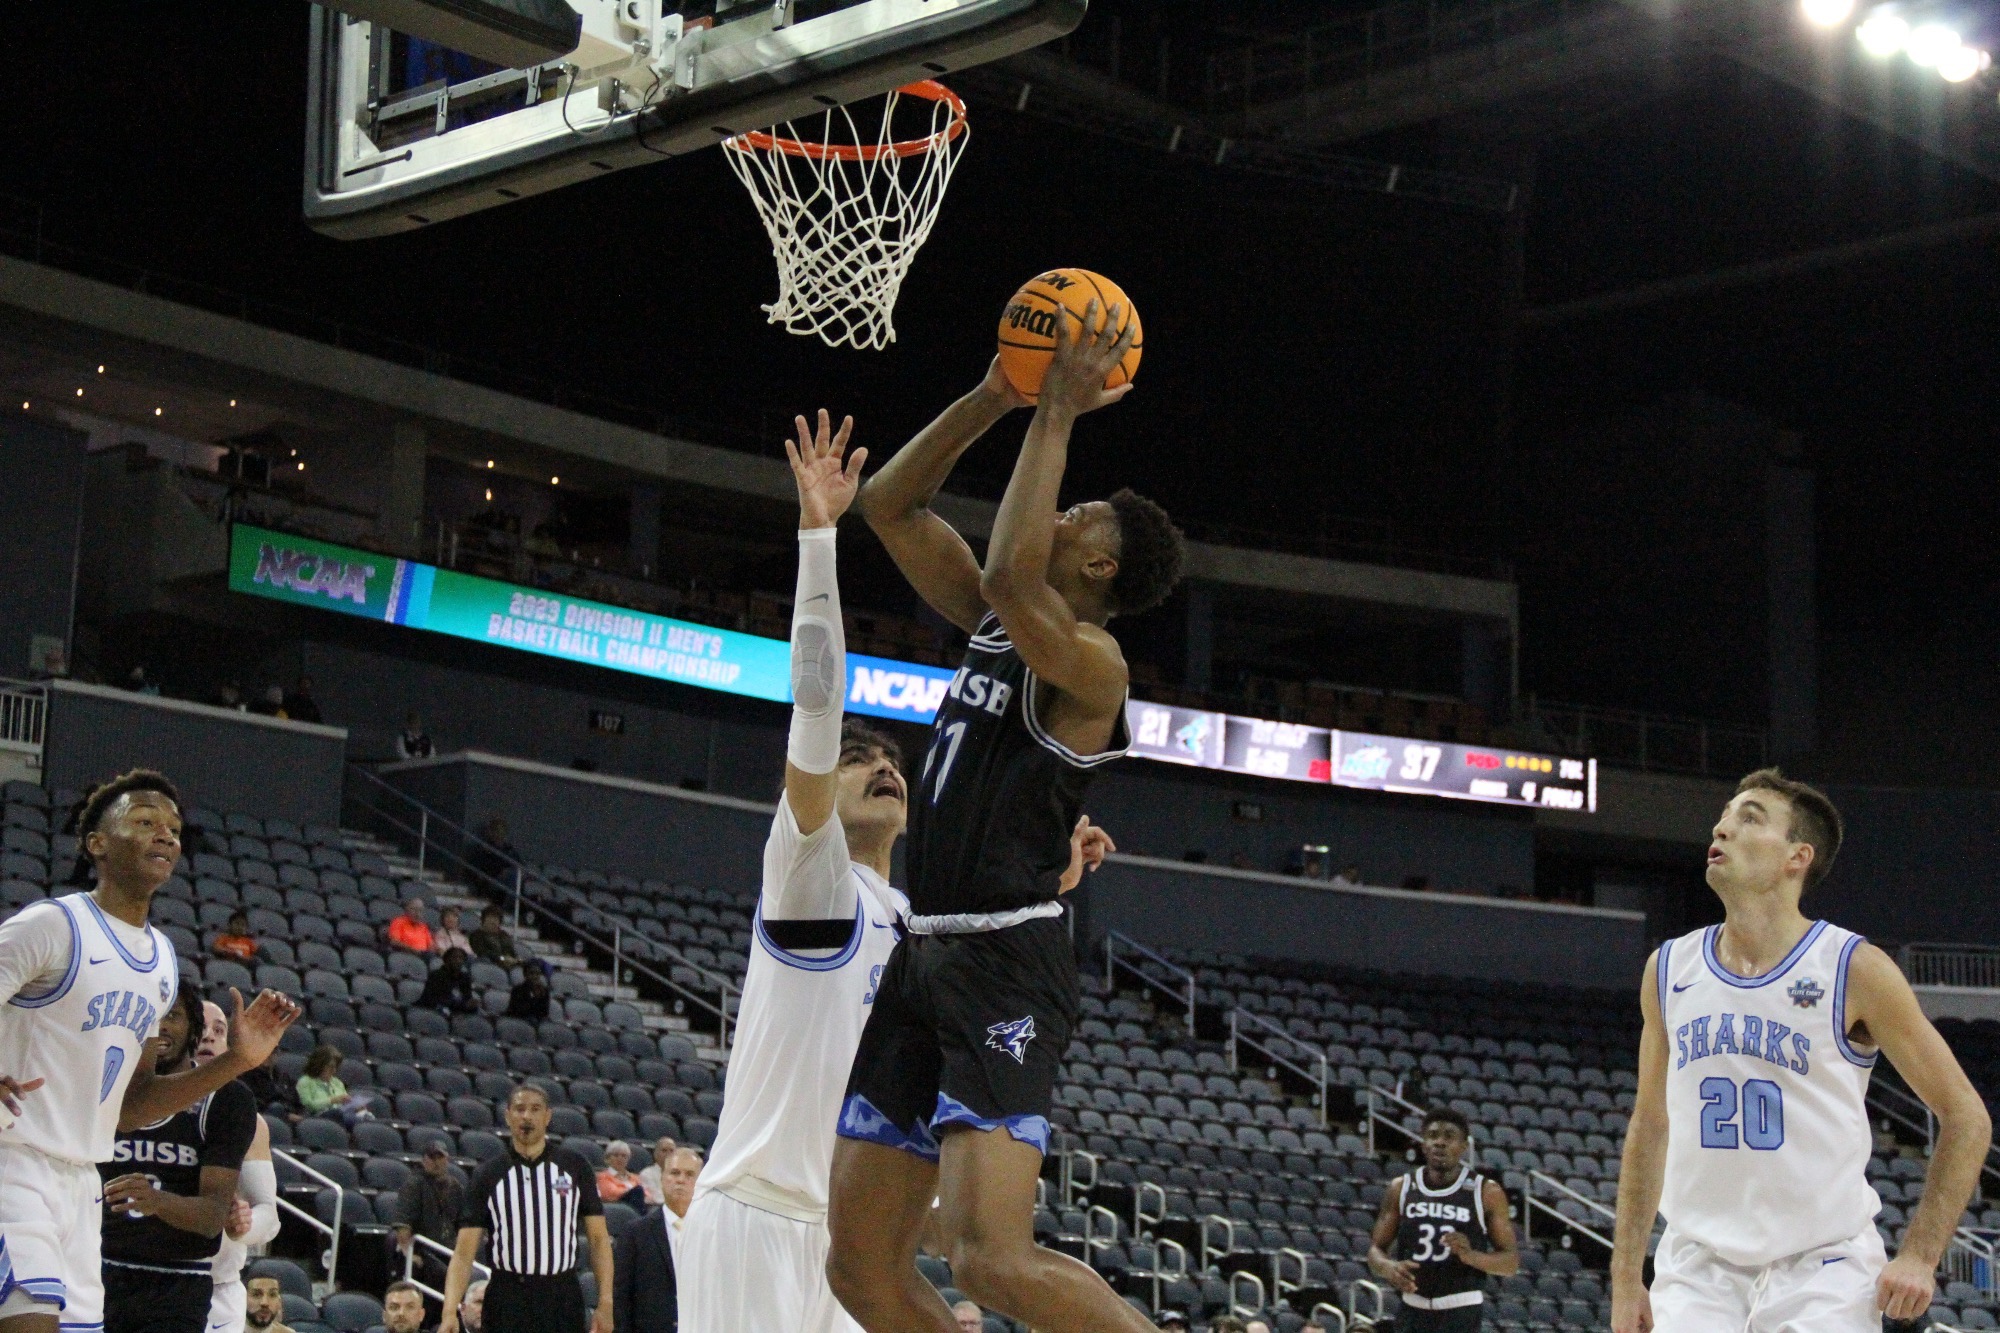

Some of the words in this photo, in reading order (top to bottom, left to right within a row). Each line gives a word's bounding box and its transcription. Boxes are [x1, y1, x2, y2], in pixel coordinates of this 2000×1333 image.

[253, 541, 367, 604] NCAA
[488, 613, 599, 658] BASKETBALL
[605, 639, 740, 685] CHAMPIONSHIP
[509, 592, 561, 623] 2023
[565, 604, 645, 642] DIVISION
[650, 623, 664, 645] II
[667, 626, 722, 658] MEN'S
[850, 665, 948, 714] NCAA
[1137, 708, 1171, 747] 21
[1400, 744, 1442, 781] 37
[1676, 1013, 1811, 1076] SHARKS
[1699, 1076, 1785, 1151] 20
[113, 1139, 199, 1167] SUSB
[1406, 1202, 1471, 1223] CSUSB
[1412, 1223, 1456, 1262] 33
